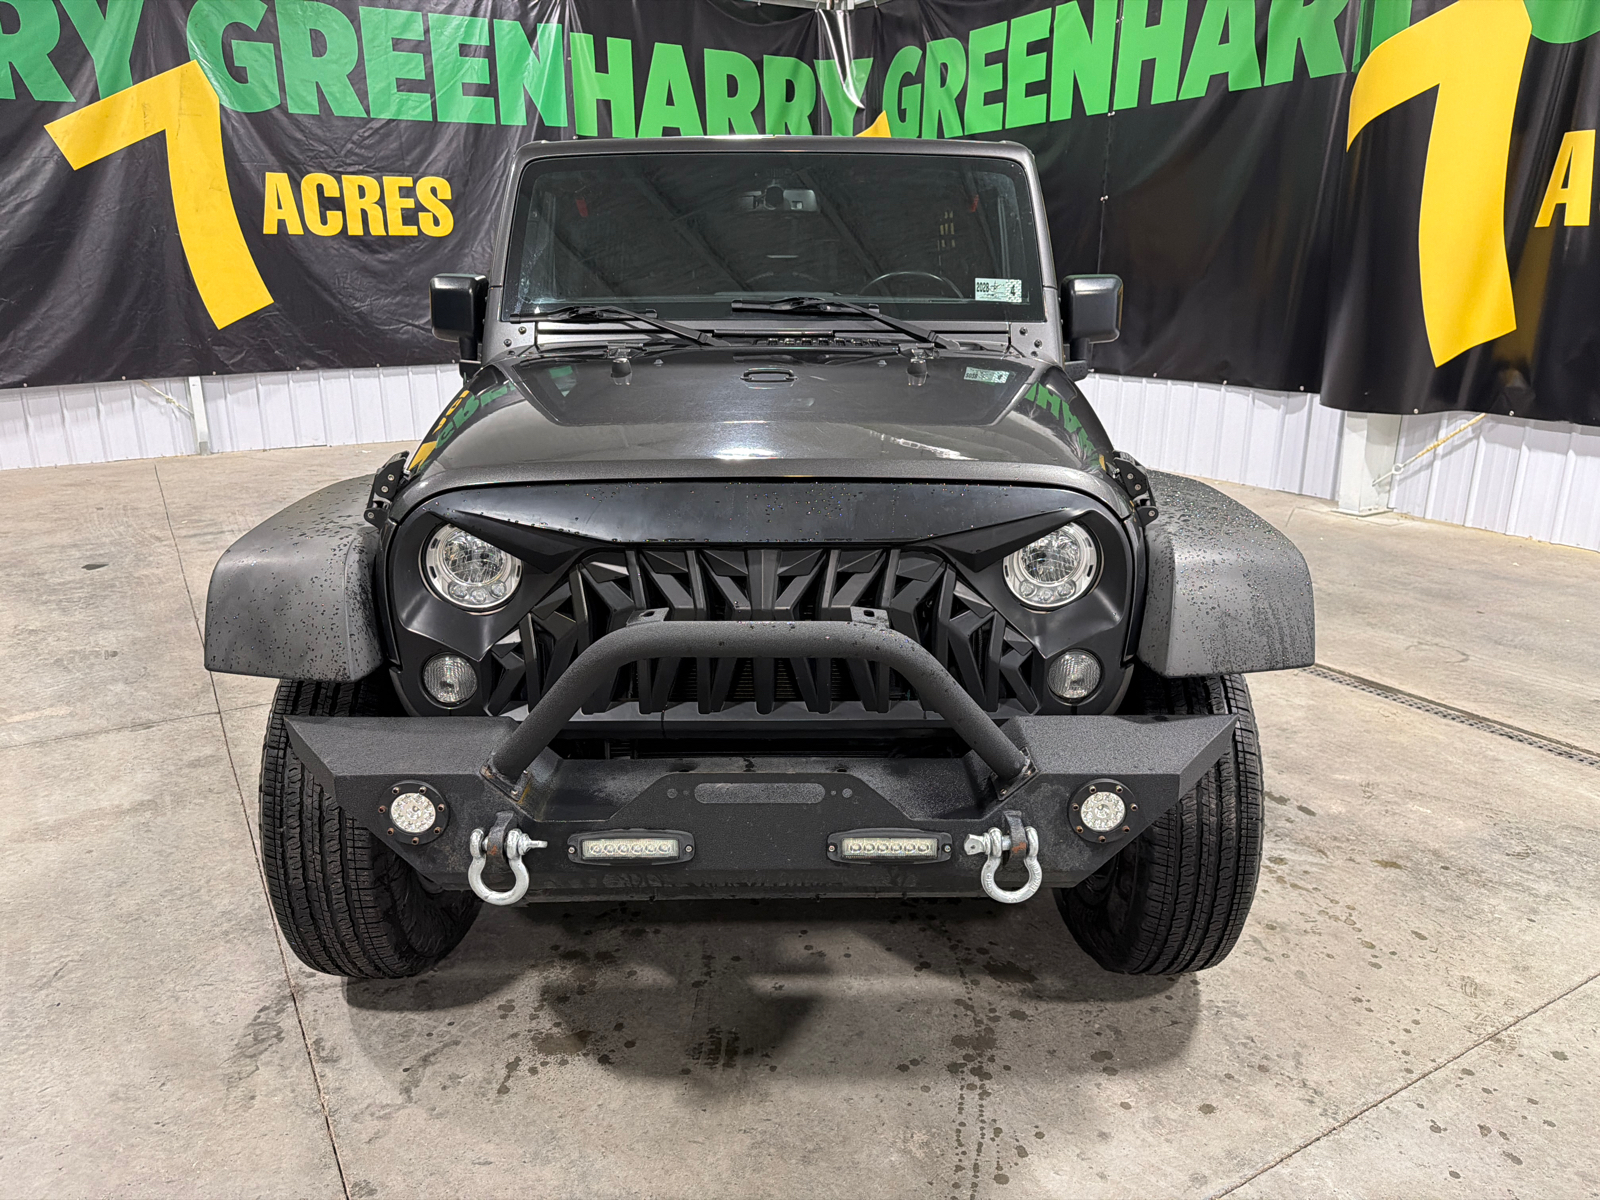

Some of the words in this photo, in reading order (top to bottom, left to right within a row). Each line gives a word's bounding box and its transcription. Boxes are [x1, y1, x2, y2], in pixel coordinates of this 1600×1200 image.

[186, 0, 569, 128] GREEN
[570, 32, 873, 139] HARRY
[883, 0, 1118, 140] GREEN
[45, 60, 275, 331] 7
[262, 172, 455, 238] ACRES
[1346, 0, 1532, 368] 7
